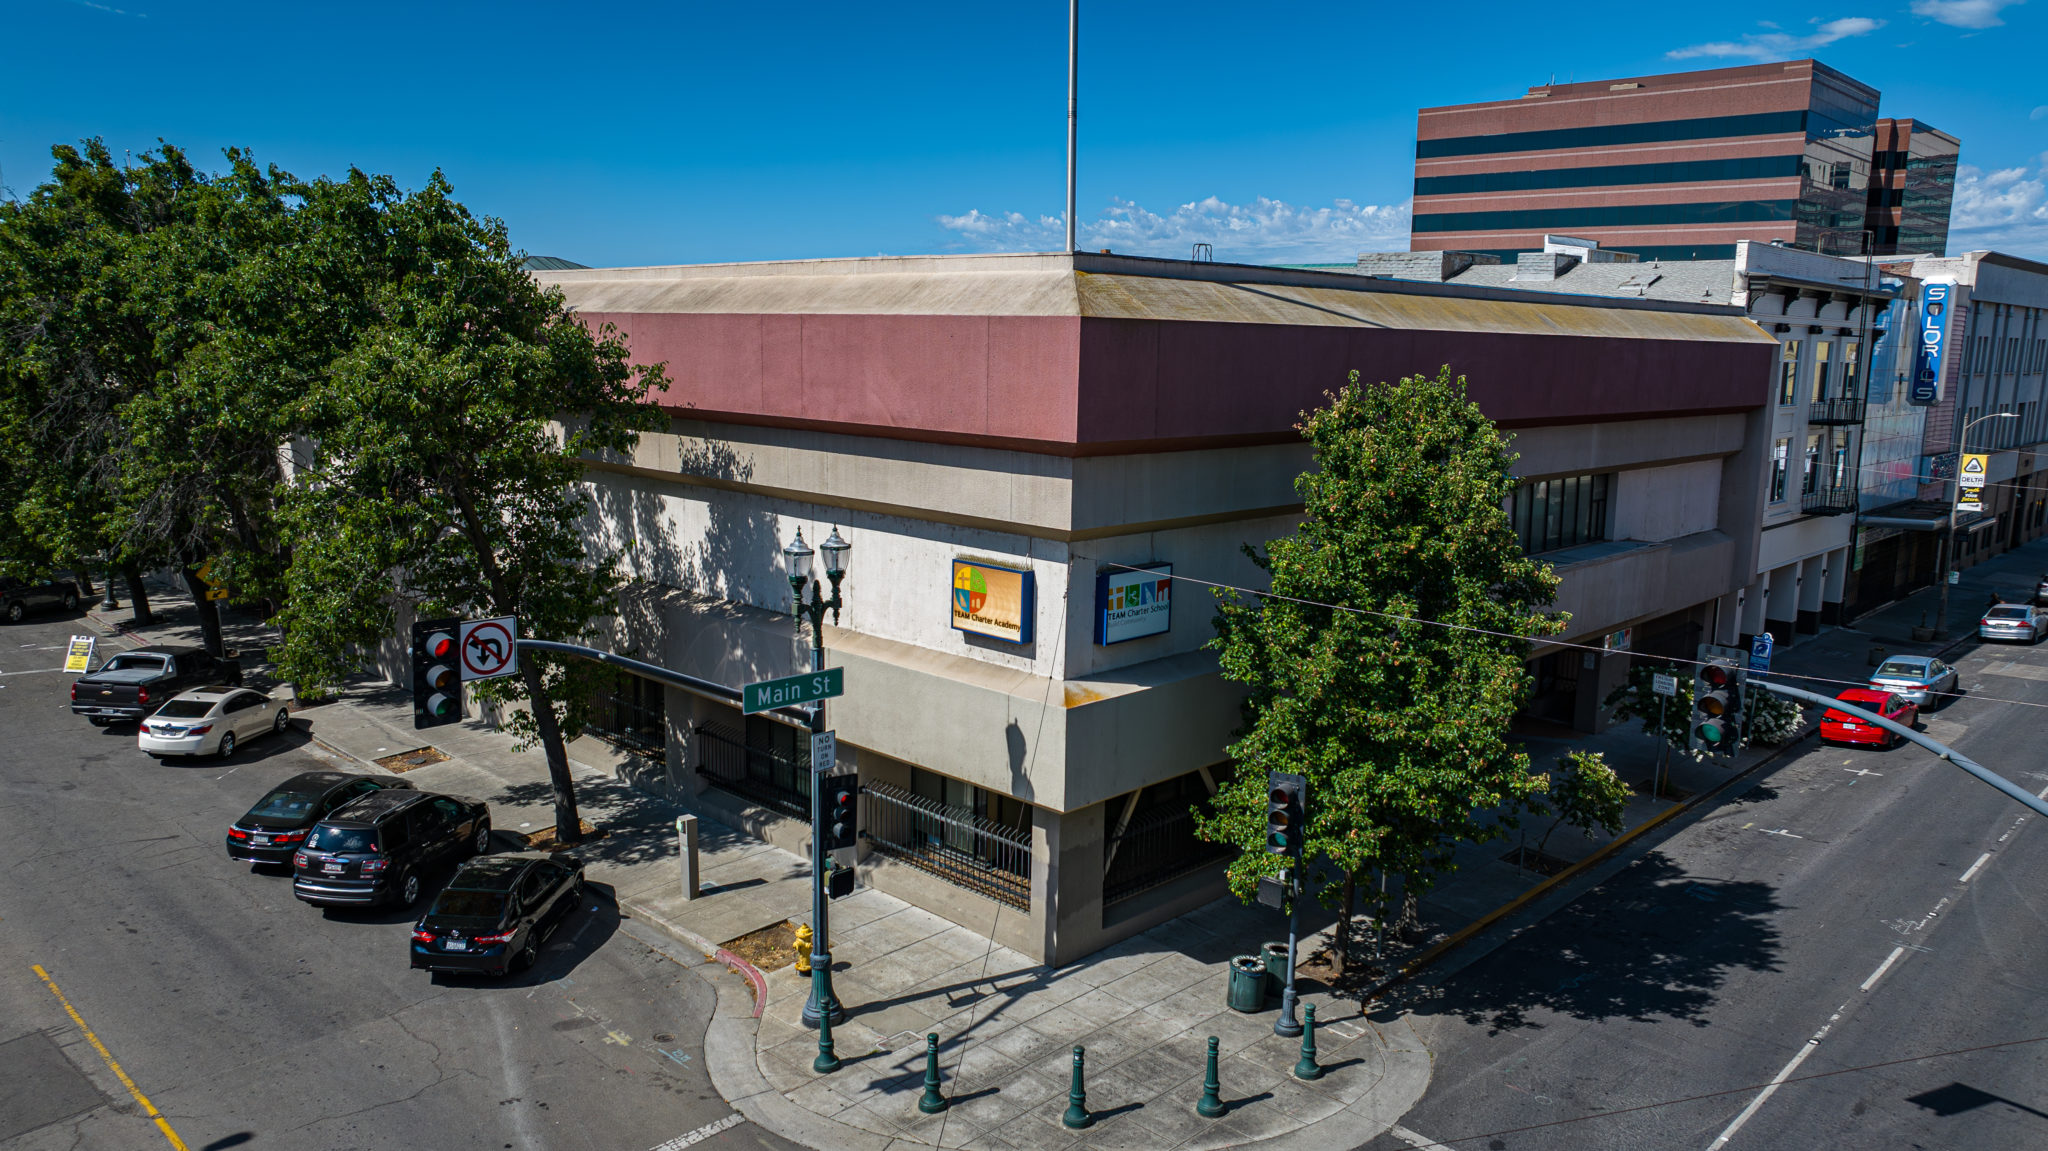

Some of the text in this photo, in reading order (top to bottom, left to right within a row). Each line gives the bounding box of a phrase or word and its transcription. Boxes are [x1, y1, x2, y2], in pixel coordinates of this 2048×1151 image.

[1107, 602, 1169, 621] TEAM Charter School
[954, 610, 970, 620] TEAM
[971, 613, 993, 625] Charter
[994, 618, 1021, 633] Academy
[758, 676, 831, 706] Main St
[818, 735, 830, 745] NO
[817, 744, 832, 753] TURN
[820, 752, 829, 760] ON
